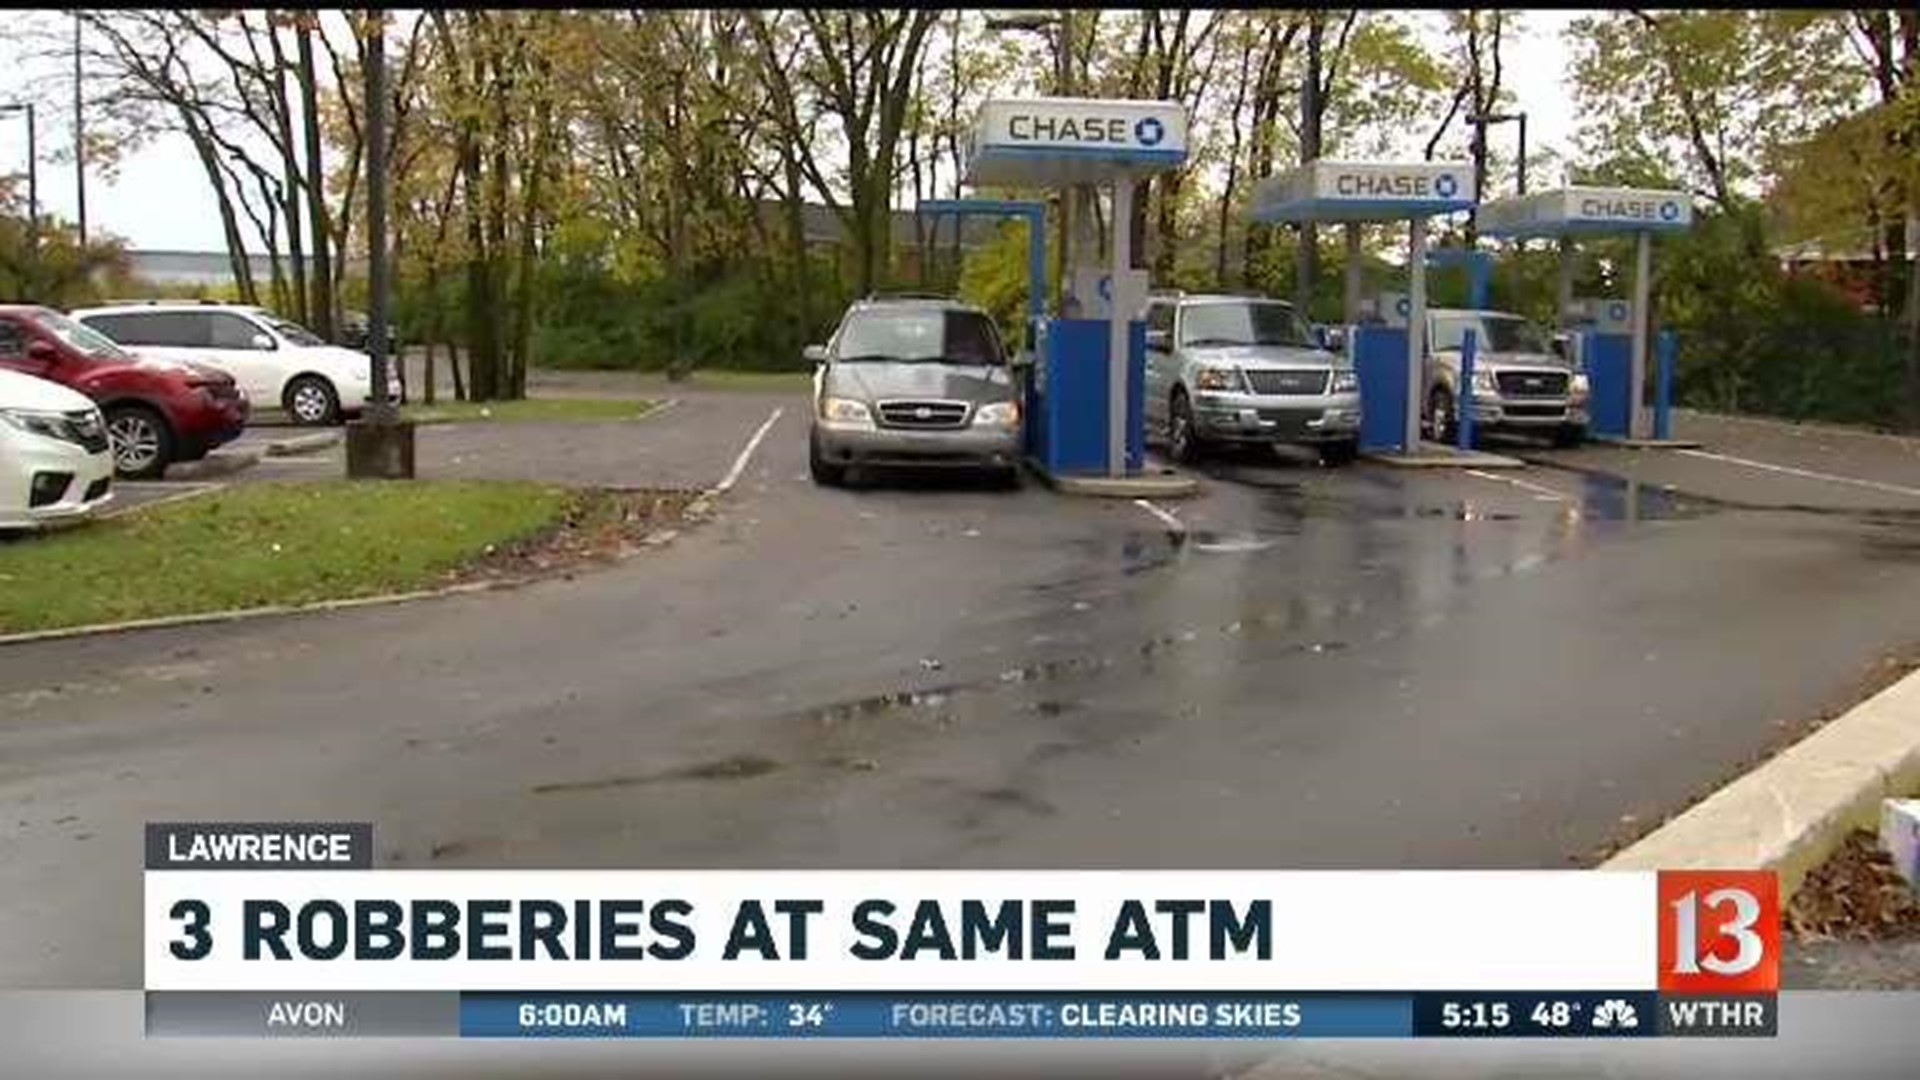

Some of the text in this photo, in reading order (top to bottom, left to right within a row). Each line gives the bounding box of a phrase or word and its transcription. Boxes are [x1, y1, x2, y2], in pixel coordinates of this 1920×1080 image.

[1008, 115, 1127, 144] CHASE
[1335, 172, 1432, 200] CHASE
[1580, 198, 1659, 219] CHASE
